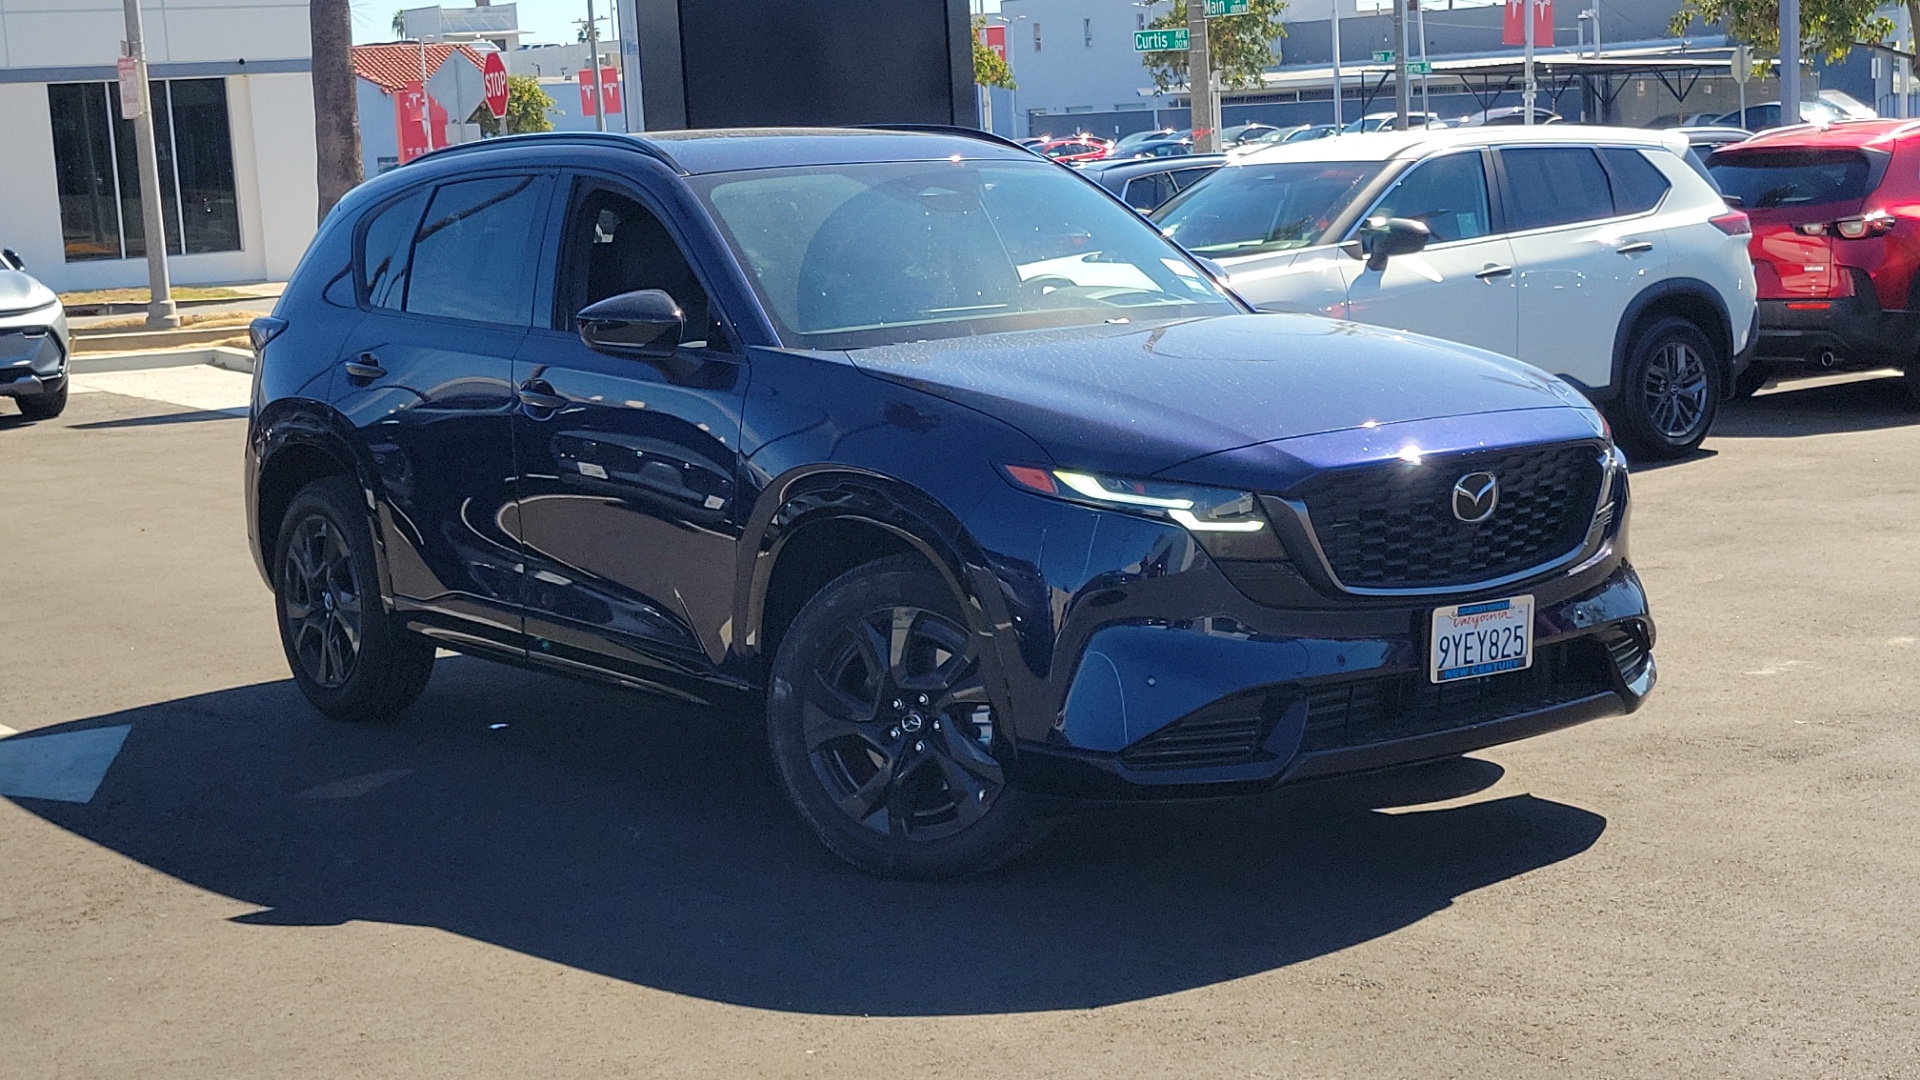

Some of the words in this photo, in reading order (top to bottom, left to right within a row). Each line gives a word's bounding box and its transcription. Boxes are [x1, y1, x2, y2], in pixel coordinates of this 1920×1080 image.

[1204, 0, 1225, 15] Main
[1135, 33, 1168, 49] Curtis
[1175, 31, 1186, 39] AVE
[485, 71, 506, 98] STOP
[1437, 625, 1524, 669] 9YEY825
